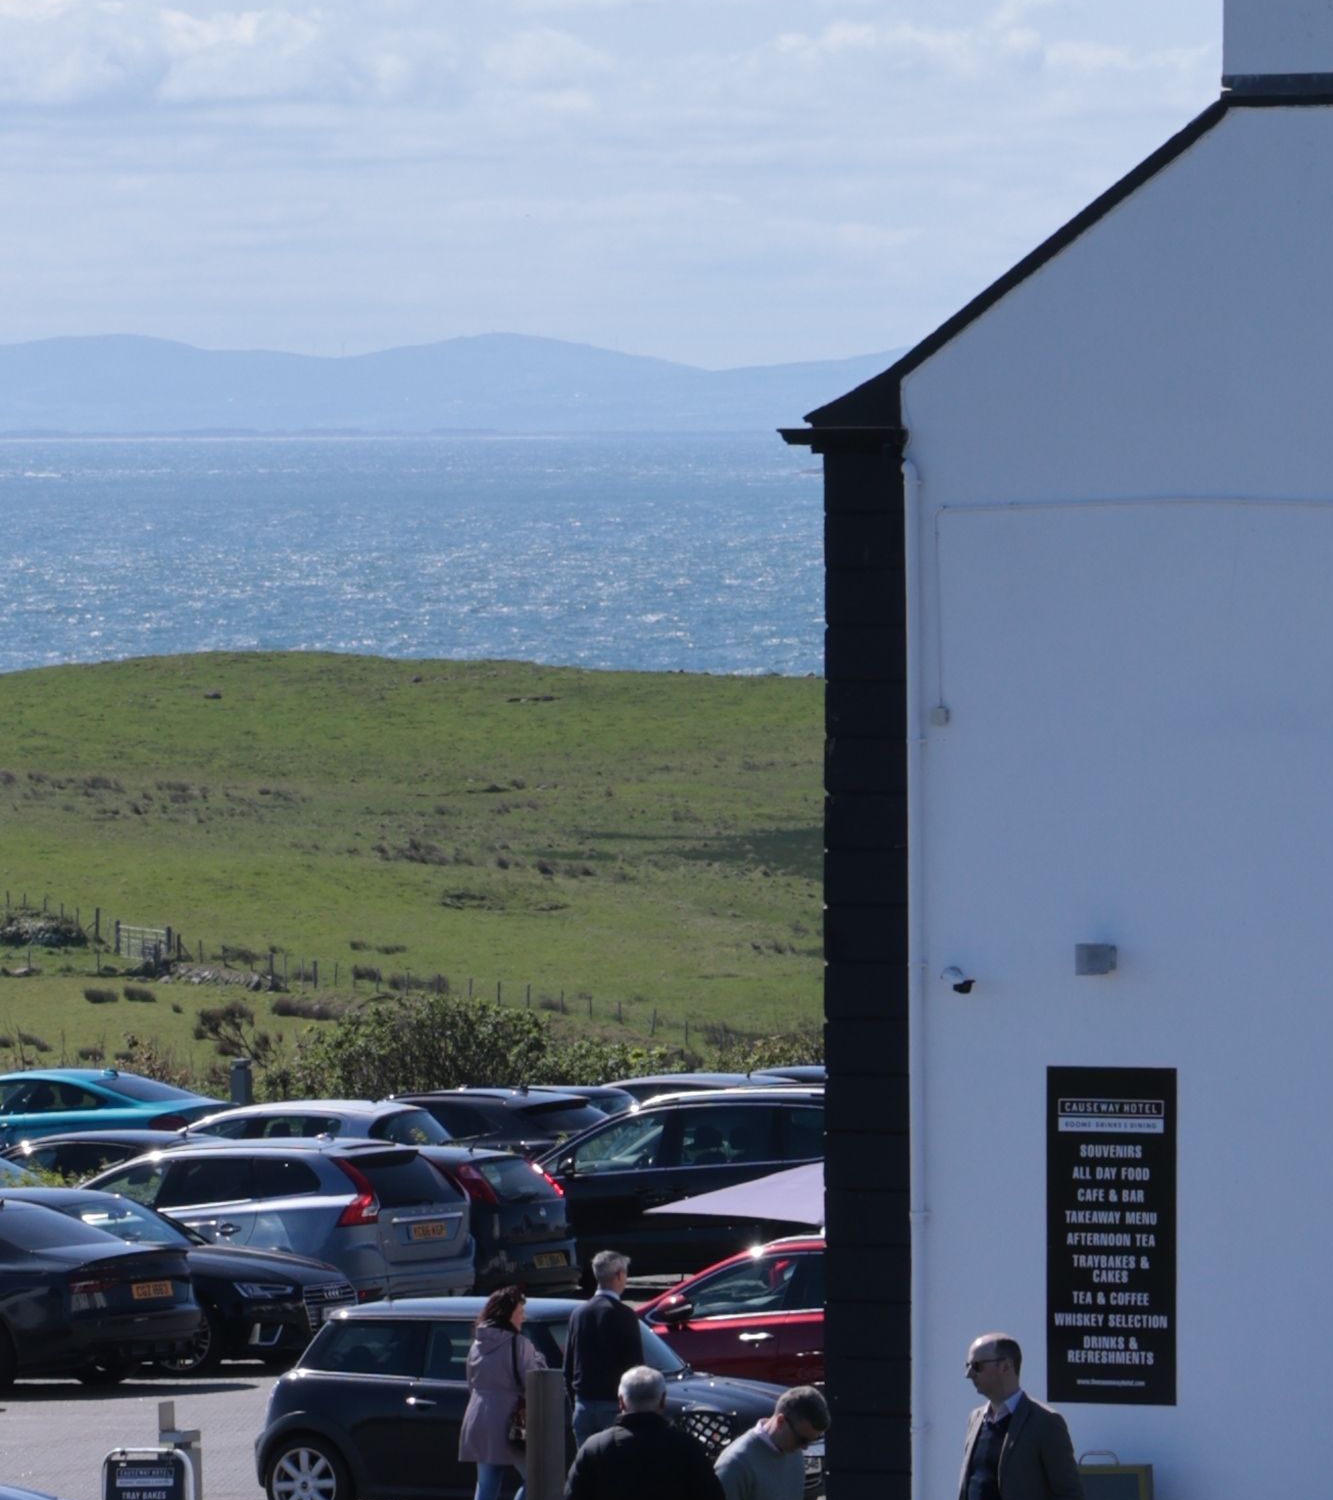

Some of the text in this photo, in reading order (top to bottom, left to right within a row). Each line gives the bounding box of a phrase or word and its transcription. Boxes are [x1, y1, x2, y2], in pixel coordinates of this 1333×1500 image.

[1064, 1102, 1158, 1114] CAUSEWAY HOTEL
[1080, 1144, 1142, 1158] SOUVENIRS
[1072, 1166, 1150, 1181] ALL DAY FOOD
[1077, 1188, 1144, 1202] CAFE & BAR
[1065, 1210, 1158, 1225] TAKEAWAY MENU
[1066, 1232, 1156, 1247] AFTERNOON TEA
[1072, 1254, 1150, 1269] TRAYBAKES &
[1092, 1269, 1128, 1283] CAKES
[1072, 1291, 1149, 1306] TEA & COFFEE
[1054, 1312, 1168, 1328] WHISKEY SELECTION
[1083, 1335, 1138, 1350] DRINKS &
[1067, 1349, 1154, 1365] REFRESHMENTS
[122, 1491, 167, 1500] TRAY BAKES
